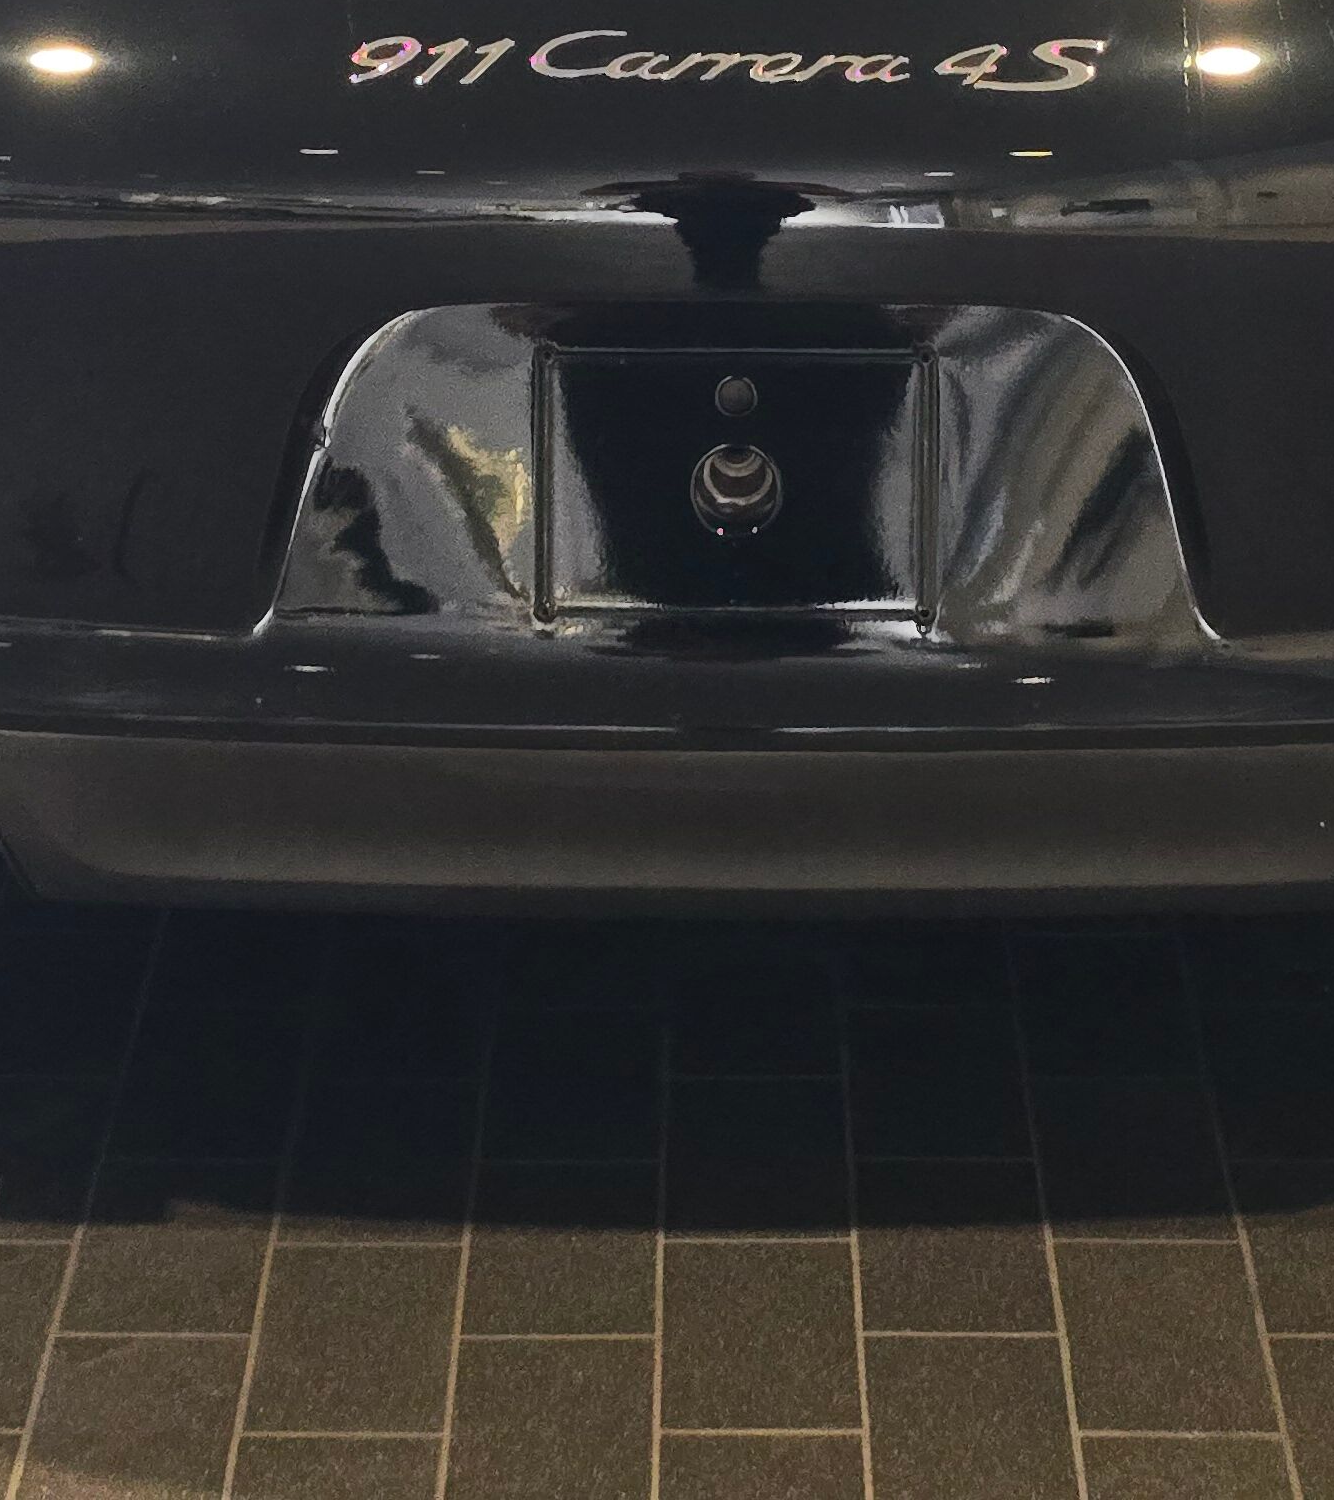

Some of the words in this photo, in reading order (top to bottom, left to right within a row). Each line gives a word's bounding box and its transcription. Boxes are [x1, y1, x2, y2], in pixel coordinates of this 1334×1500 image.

[349, 35, 516, 87] 911
[529, 29, 910, 85] Carrera
[934, 38, 1108, 92] 4S
